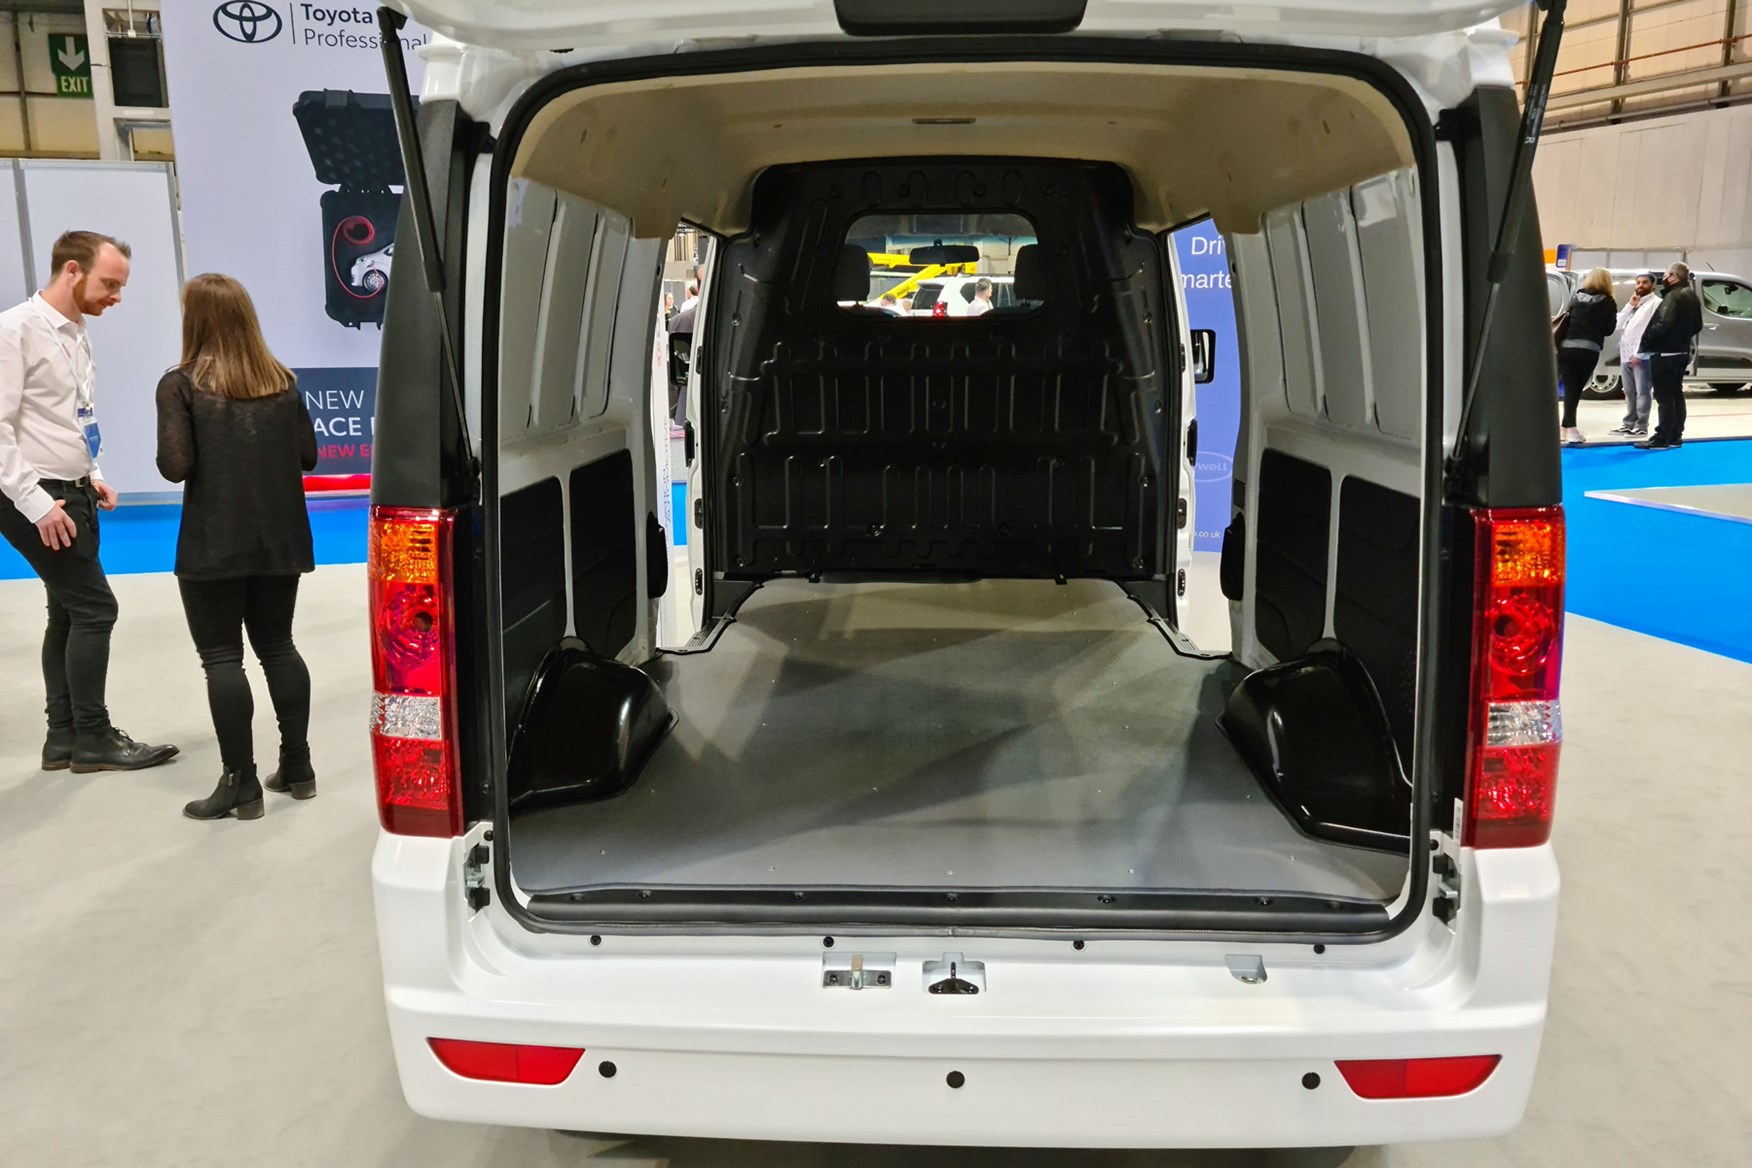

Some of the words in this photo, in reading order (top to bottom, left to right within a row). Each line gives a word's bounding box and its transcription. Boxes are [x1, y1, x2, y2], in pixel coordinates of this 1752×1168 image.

[300, 3, 373, 26] Toyota
[304, 28, 427, 50] Professnal
[61, 75, 89, 92] EXIT
[1191, 235, 1225, 255] Dri
[305, 390, 364, 410] NEW
[313, 416, 362, 436] ACE
